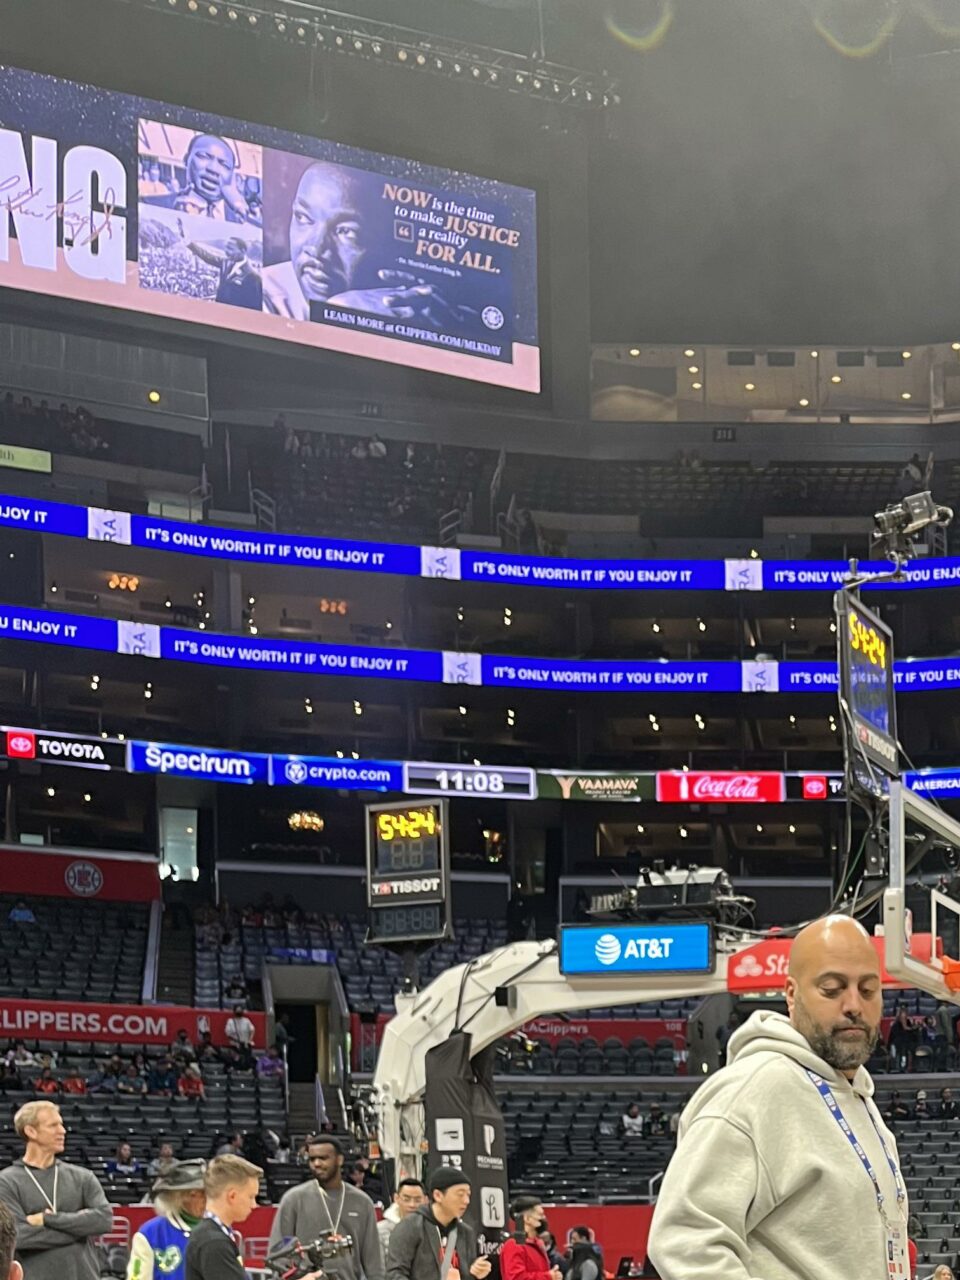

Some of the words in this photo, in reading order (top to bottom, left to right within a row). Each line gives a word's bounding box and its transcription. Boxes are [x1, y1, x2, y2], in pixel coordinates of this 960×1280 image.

[382, 183, 432, 208] NOW
[432, 197, 443, 210] is
[444, 200, 465, 216] the
[467, 206, 495, 222] time
[394, 205, 408, 217] to
[410, 209, 444, 225] make
[443, 215, 520, 247] JUSTICE
[418, 227, 426, 237] a
[428, 228, 468, 249] reality
[416, 239, 455, 263] FOR
[459, 250, 501, 274] ALL.
[324, 308, 355, 324] LEARN
[357, 316, 385, 331] MORE
[145, 527, 170, 543] IT'S
[172, 531, 208, 548] ONLY
[210, 537, 261, 555] WORTH
[263, 543, 276, 556] IT
[278, 544, 291, 557] IF
[294, 546, 323, 560] YOU
[325, 548, 369, 564] ENJOY
[372, 552, 385, 565] IT
[473, 561, 496, 575] IT'S
[497, 563, 531, 578] ONLY
[531, 566, 579, 581] WORTH
[580, 569, 593, 581] IT
[594, 570, 606, 582] IF
[608, 569, 635, 582] YOU
[636, 570, 678, 582] ENJOY
[680, 570, 693, 582] IT
[774, 570, 797, 583] IT'S
[797, 571, 830, 583] ONLY
[905, 568, 931, 582] YOU
[849, 611, 886, 669] 54:24
[174, 640, 199, 655] IT'S
[200, 643, 236, 659] ONLY
[237, 647, 288, 663] WORTH
[290, 652, 302, 664] IT
[304, 653, 317, 665] IF
[319, 654, 348, 668] YOU
[350, 656, 393, 670] ENJOY
[395, 659, 408, 671] IT
[493, 666, 516, 679] IT'S
[517, 668, 550, 682] ONLY
[551, 670, 597, 683] WORTH
[599, 672, 610, 683] IT
[612, 672, 624, 683] IF
[626, 672, 652, 684] YOU
[654, 672, 695, 684] ENJOY
[696, 672, 709, 684] IT
[790, 671, 812, 684] IT'S
[905, 671, 917, 683] IF
[918, 670, 944, 682] YOU
[39, 739, 105, 760] TOYOTA
[867, 732, 897, 762] TISSOT
[145, 746, 252, 776] Spectrum
[309, 765, 392, 784] crypto.com
[434, 770, 505, 793] 11:08
[378, 811, 436, 840] 54:24
[390, 878, 440, 894] TISSOT
[624, 937, 674, 960] AT&T
[2, 1008, 168, 1036] LIPPERS.COM
